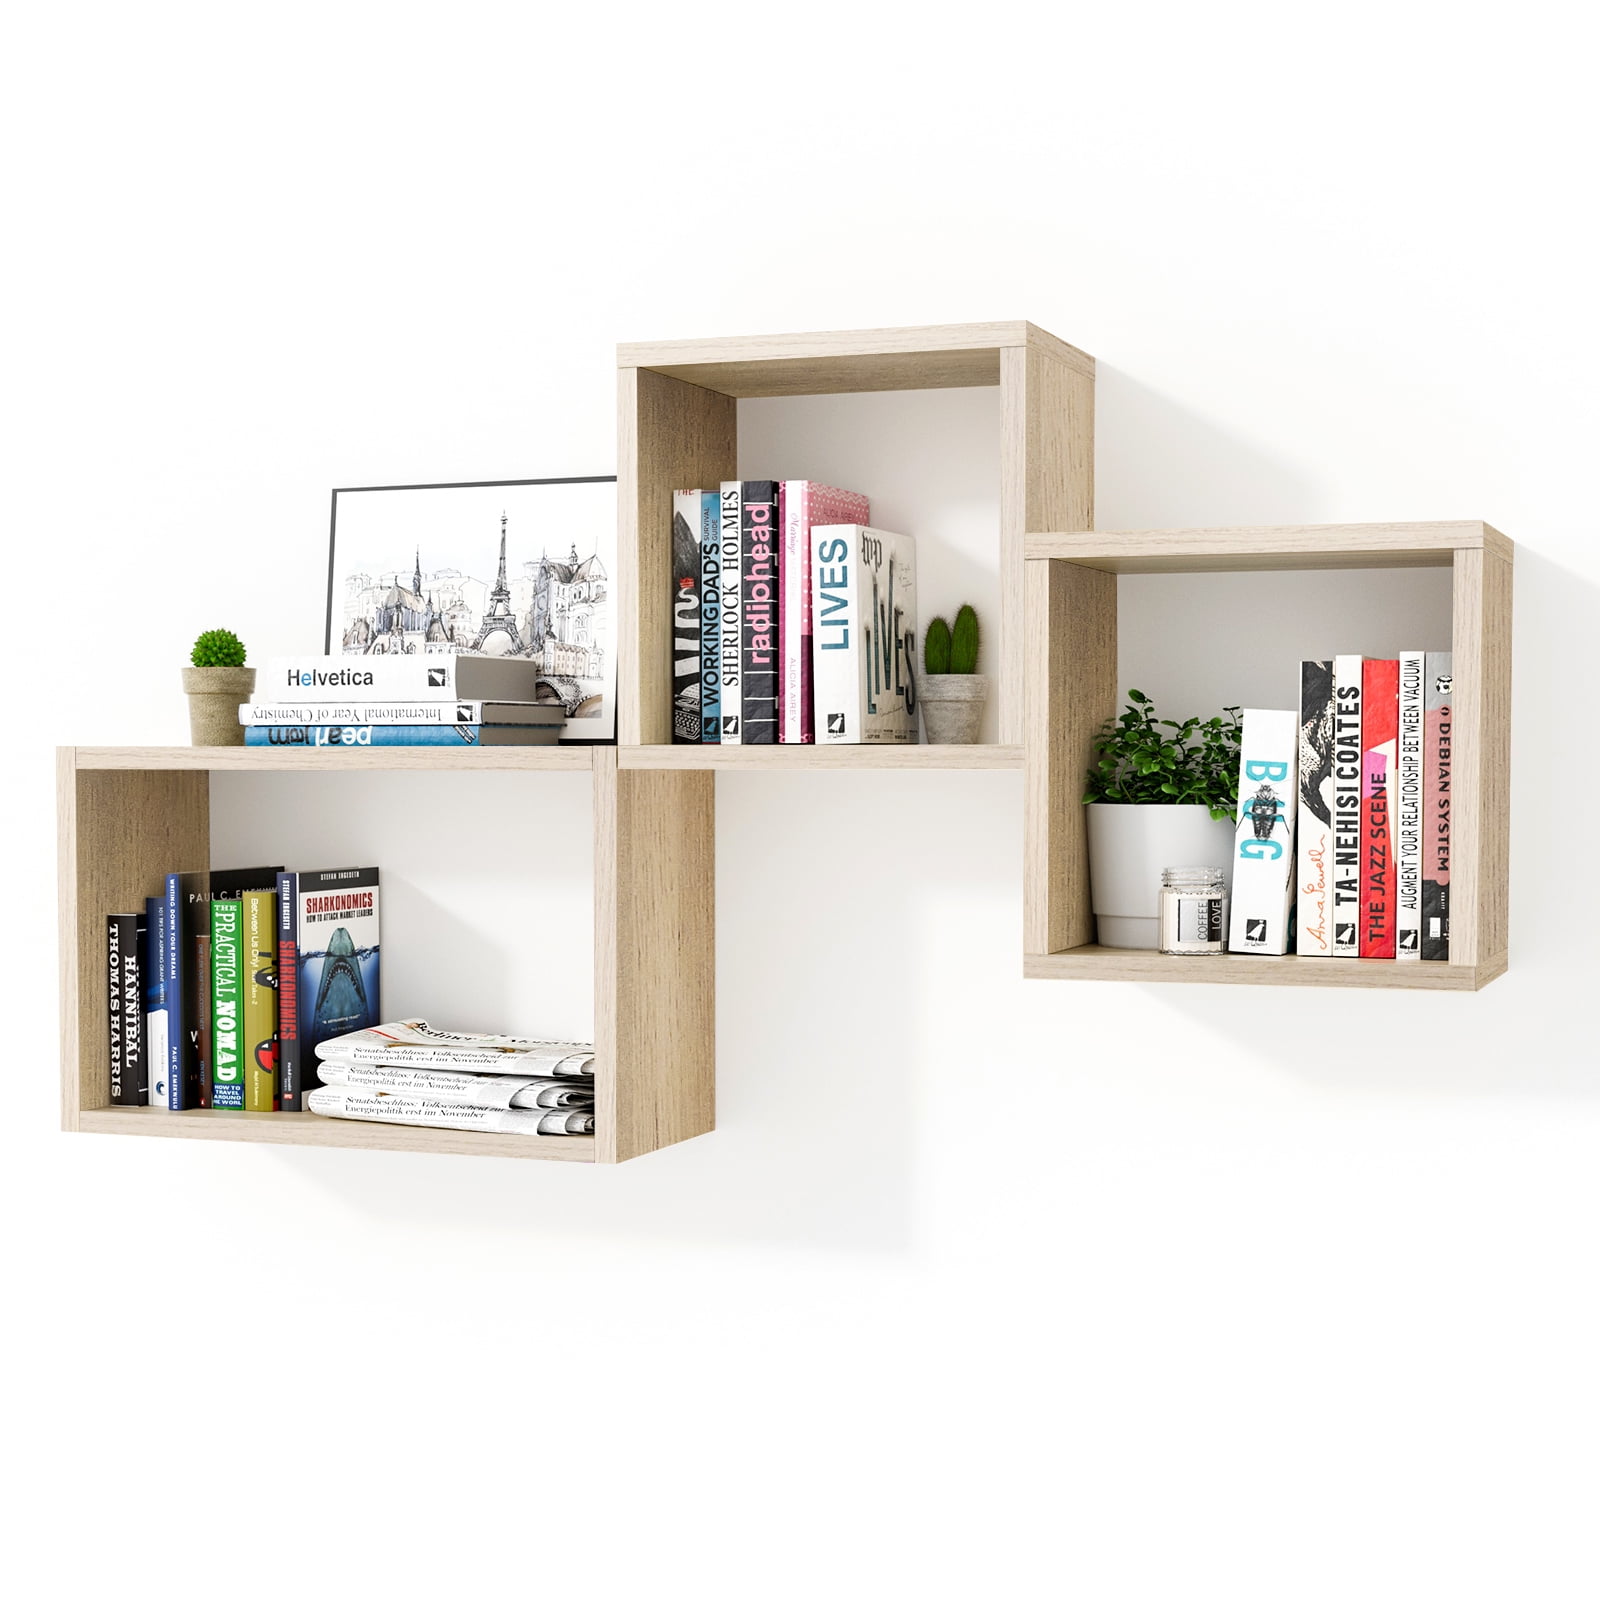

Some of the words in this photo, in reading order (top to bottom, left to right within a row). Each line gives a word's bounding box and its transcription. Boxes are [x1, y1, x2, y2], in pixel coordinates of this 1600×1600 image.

[722, 490, 739, 571] HOLMES
[703, 543, 720, 605] DAD'S
[745, 504, 770, 664] radiohead
[818, 538, 849, 650] LIVES
[722, 582, 739, 686] SHERLOCK
[864, 552, 917, 716] LIVES
[287, 668, 374, 686] Helvetica
[703, 607, 719, 707] WORKING
[789, 657, 797, 689] ALICIA
[1403, 658, 1420, 702] VACUUM
[252, 706, 313, 723] Chemistry
[316, 707, 329, 722] of
[332, 709, 360, 722] Year
[364, 707, 442, 722] International
[789, 692, 797, 722] AIREY
[315, 725, 374, 746] pearl
[1336, 686, 1360, 780] COATES
[1402, 705, 1420, 753] BETWEEN
[1438, 723, 1450, 793] DEBIAN
[1371, 773, 1387, 839] SCENE
[1402, 756, 1419, 827] RELATIONSHIP
[1335, 786, 1359, 907] TA-NEHISI
[1402, 829, 1418, 858] YOUR
[1437, 798, 1450, 872] SYSTEM
[282, 879, 290, 900] STEFAN
[1370, 845, 1386, 897] JAZZ
[1401, 860, 1417, 910] AUGMENT
[189, 892, 215, 904] PAUL
[250, 898, 259, 935] Between
[306, 892, 373, 914] SHARKONOMICS
[306, 915, 316, 923] HOW
[317, 914, 322, 922] TO
[323, 912, 339, 921] ATTACK
[340, 910, 356, 919] MARKET
[356, 908, 373, 917] LEADERS
[1212, 900, 1222, 930] LOVE
[1197, 901, 1208, 940] COFFEE
[1369, 902, 1385, 943] THE
[215, 912, 237, 997] PRACTICAL
[250, 948, 259, 967] Only!
[251, 936, 259, 948] Us
[109, 923, 120, 1011] THOMAS
[124, 955, 138, 1068] HANNIBAL
[279, 941, 296, 1040] SHARKONOMICS
[110, 1014, 122, 1097] HARRIS
[216, 1000, 237, 1081] NOMAD
[450, 1056, 498, 1064] November
[345, 1096, 418, 1108] Senatsbeschluss:
[347, 1075, 396, 1087] Energiepolitik
[397, 1079, 413, 1087] erst
[413, 1080, 425, 1088] im
[426, 1081, 468, 1091] November
[345, 1104, 404, 1116] Energiepolitik
[405, 1108, 422, 1116] erst
[438, 1108, 486, 1119] November
